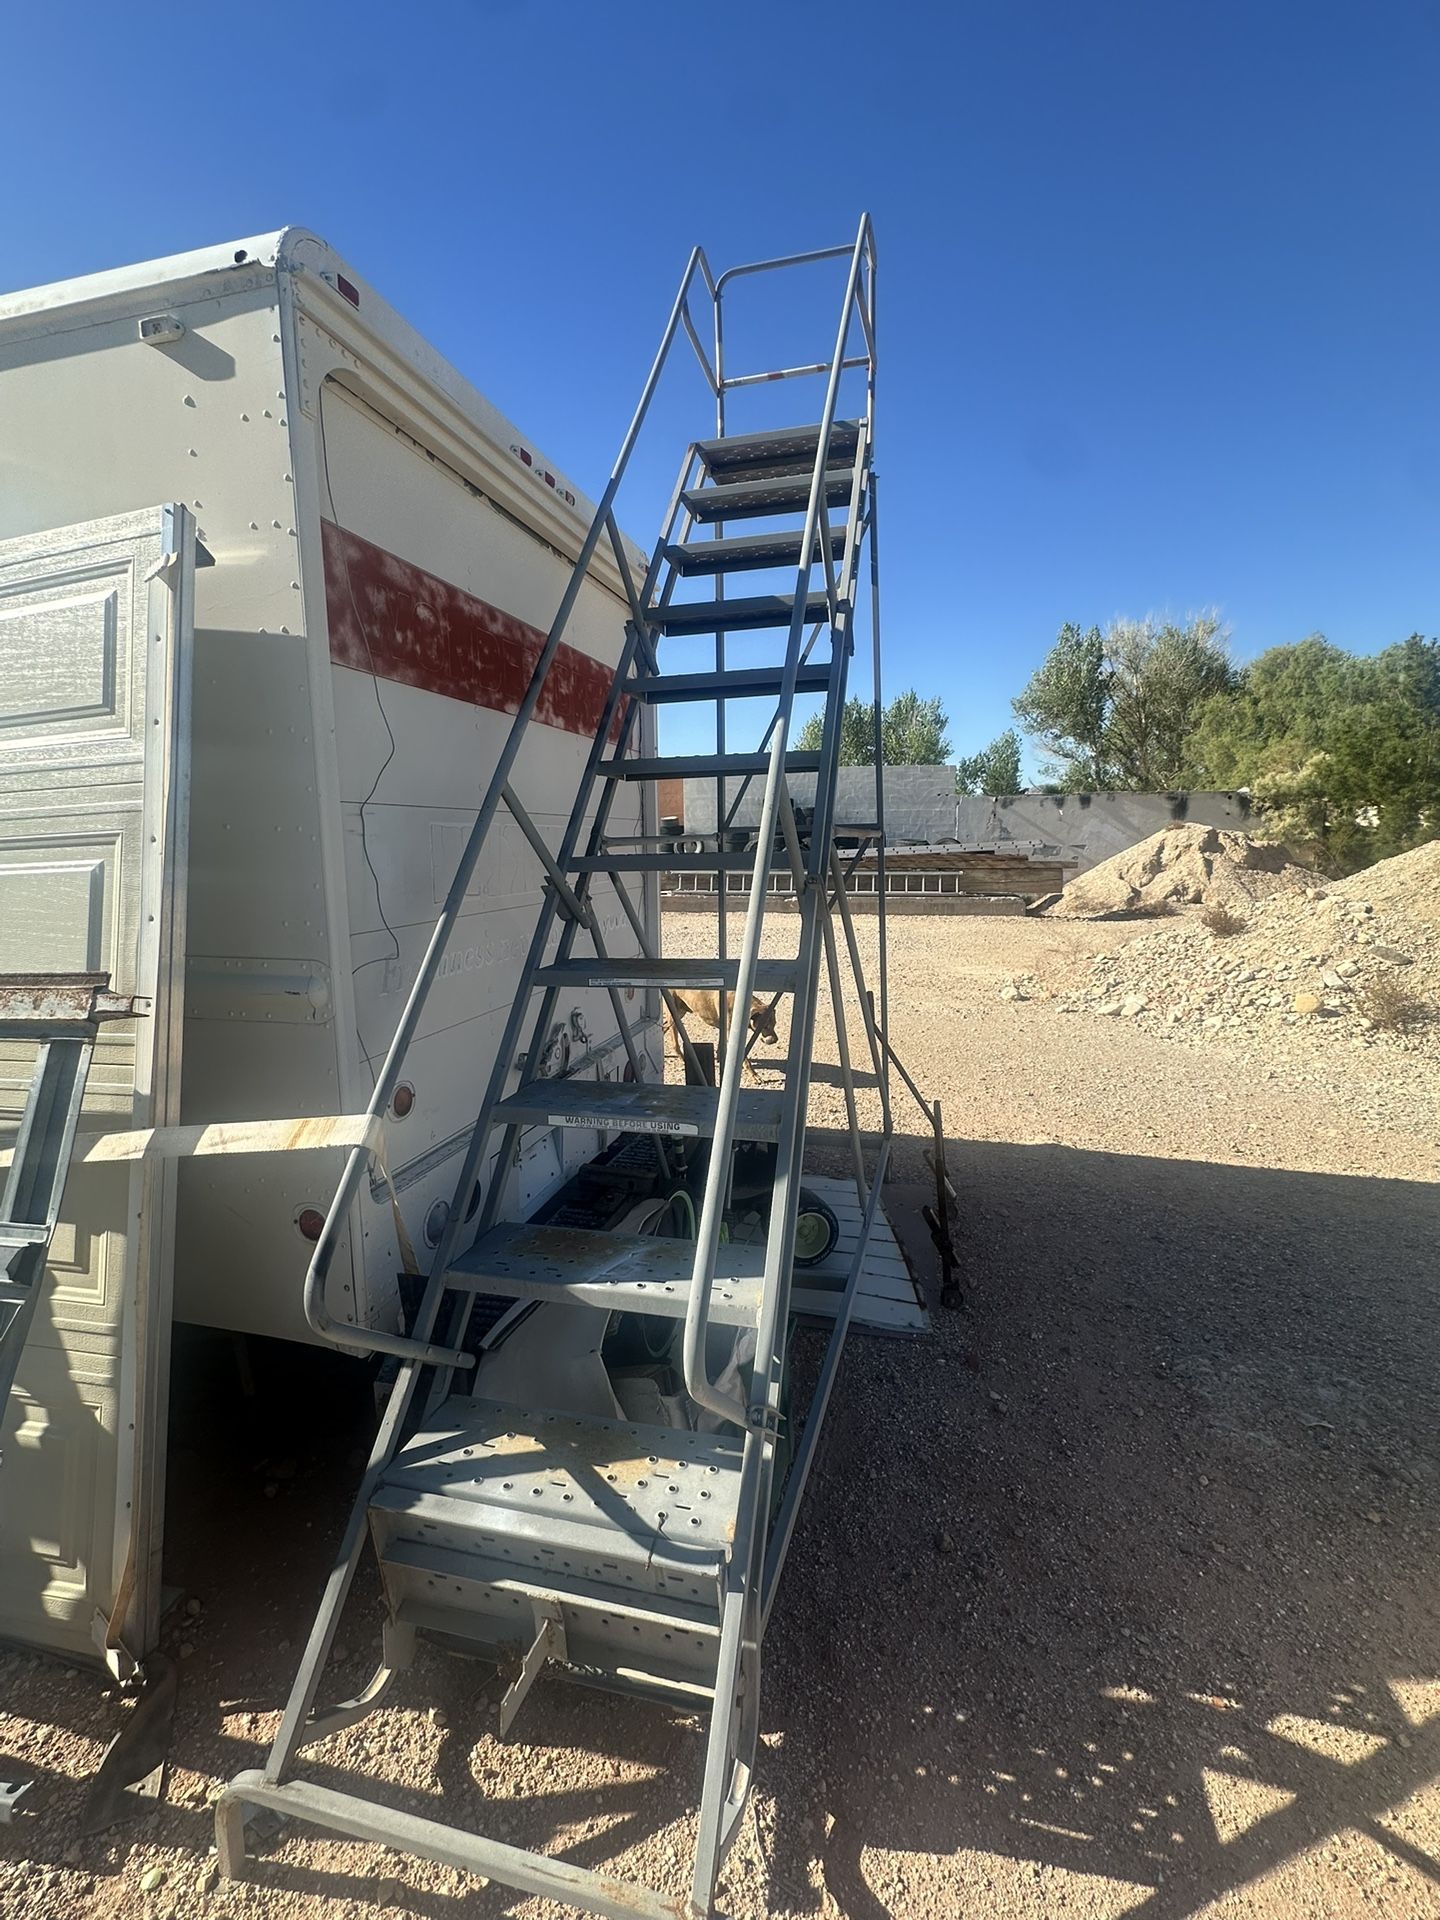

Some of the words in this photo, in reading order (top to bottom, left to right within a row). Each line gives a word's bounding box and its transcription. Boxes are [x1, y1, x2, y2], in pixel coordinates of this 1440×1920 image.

[565, 1116, 610, 1127] WARNING
[613, 1118, 648, 1129] BEFORE
[650, 1121, 681, 1131] USING
